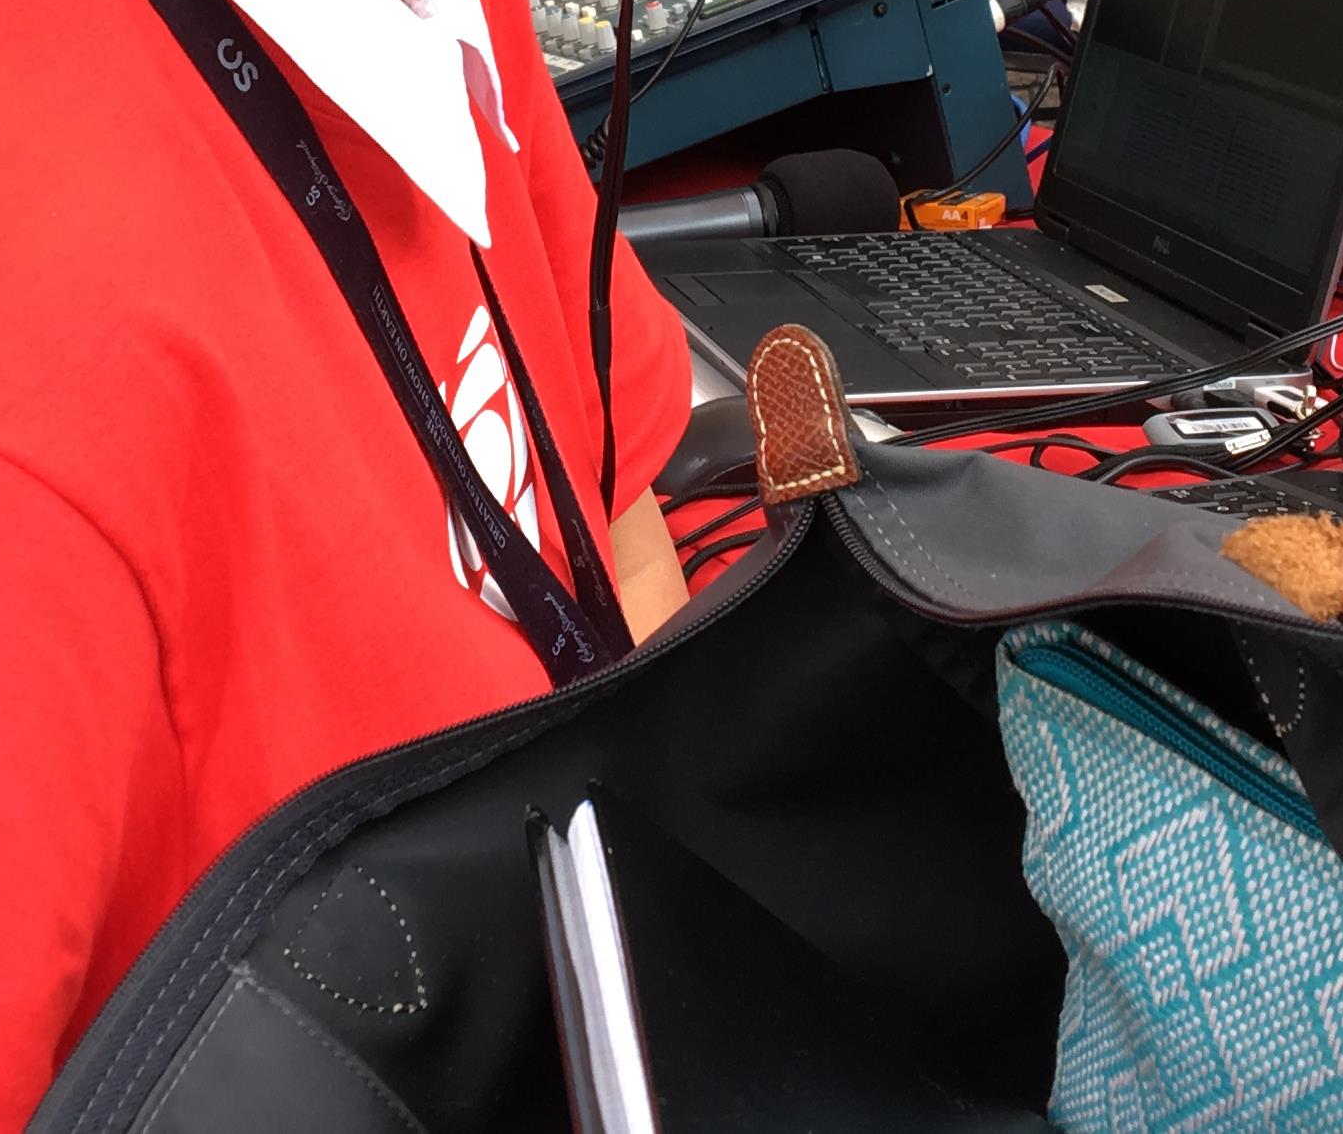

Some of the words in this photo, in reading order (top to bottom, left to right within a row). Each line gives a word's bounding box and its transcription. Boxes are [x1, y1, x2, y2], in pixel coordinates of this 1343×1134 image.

[393, 337, 408, 362] ON
[425, 413, 446, 450] THE
[464, 476, 506, 551] GREATEST
